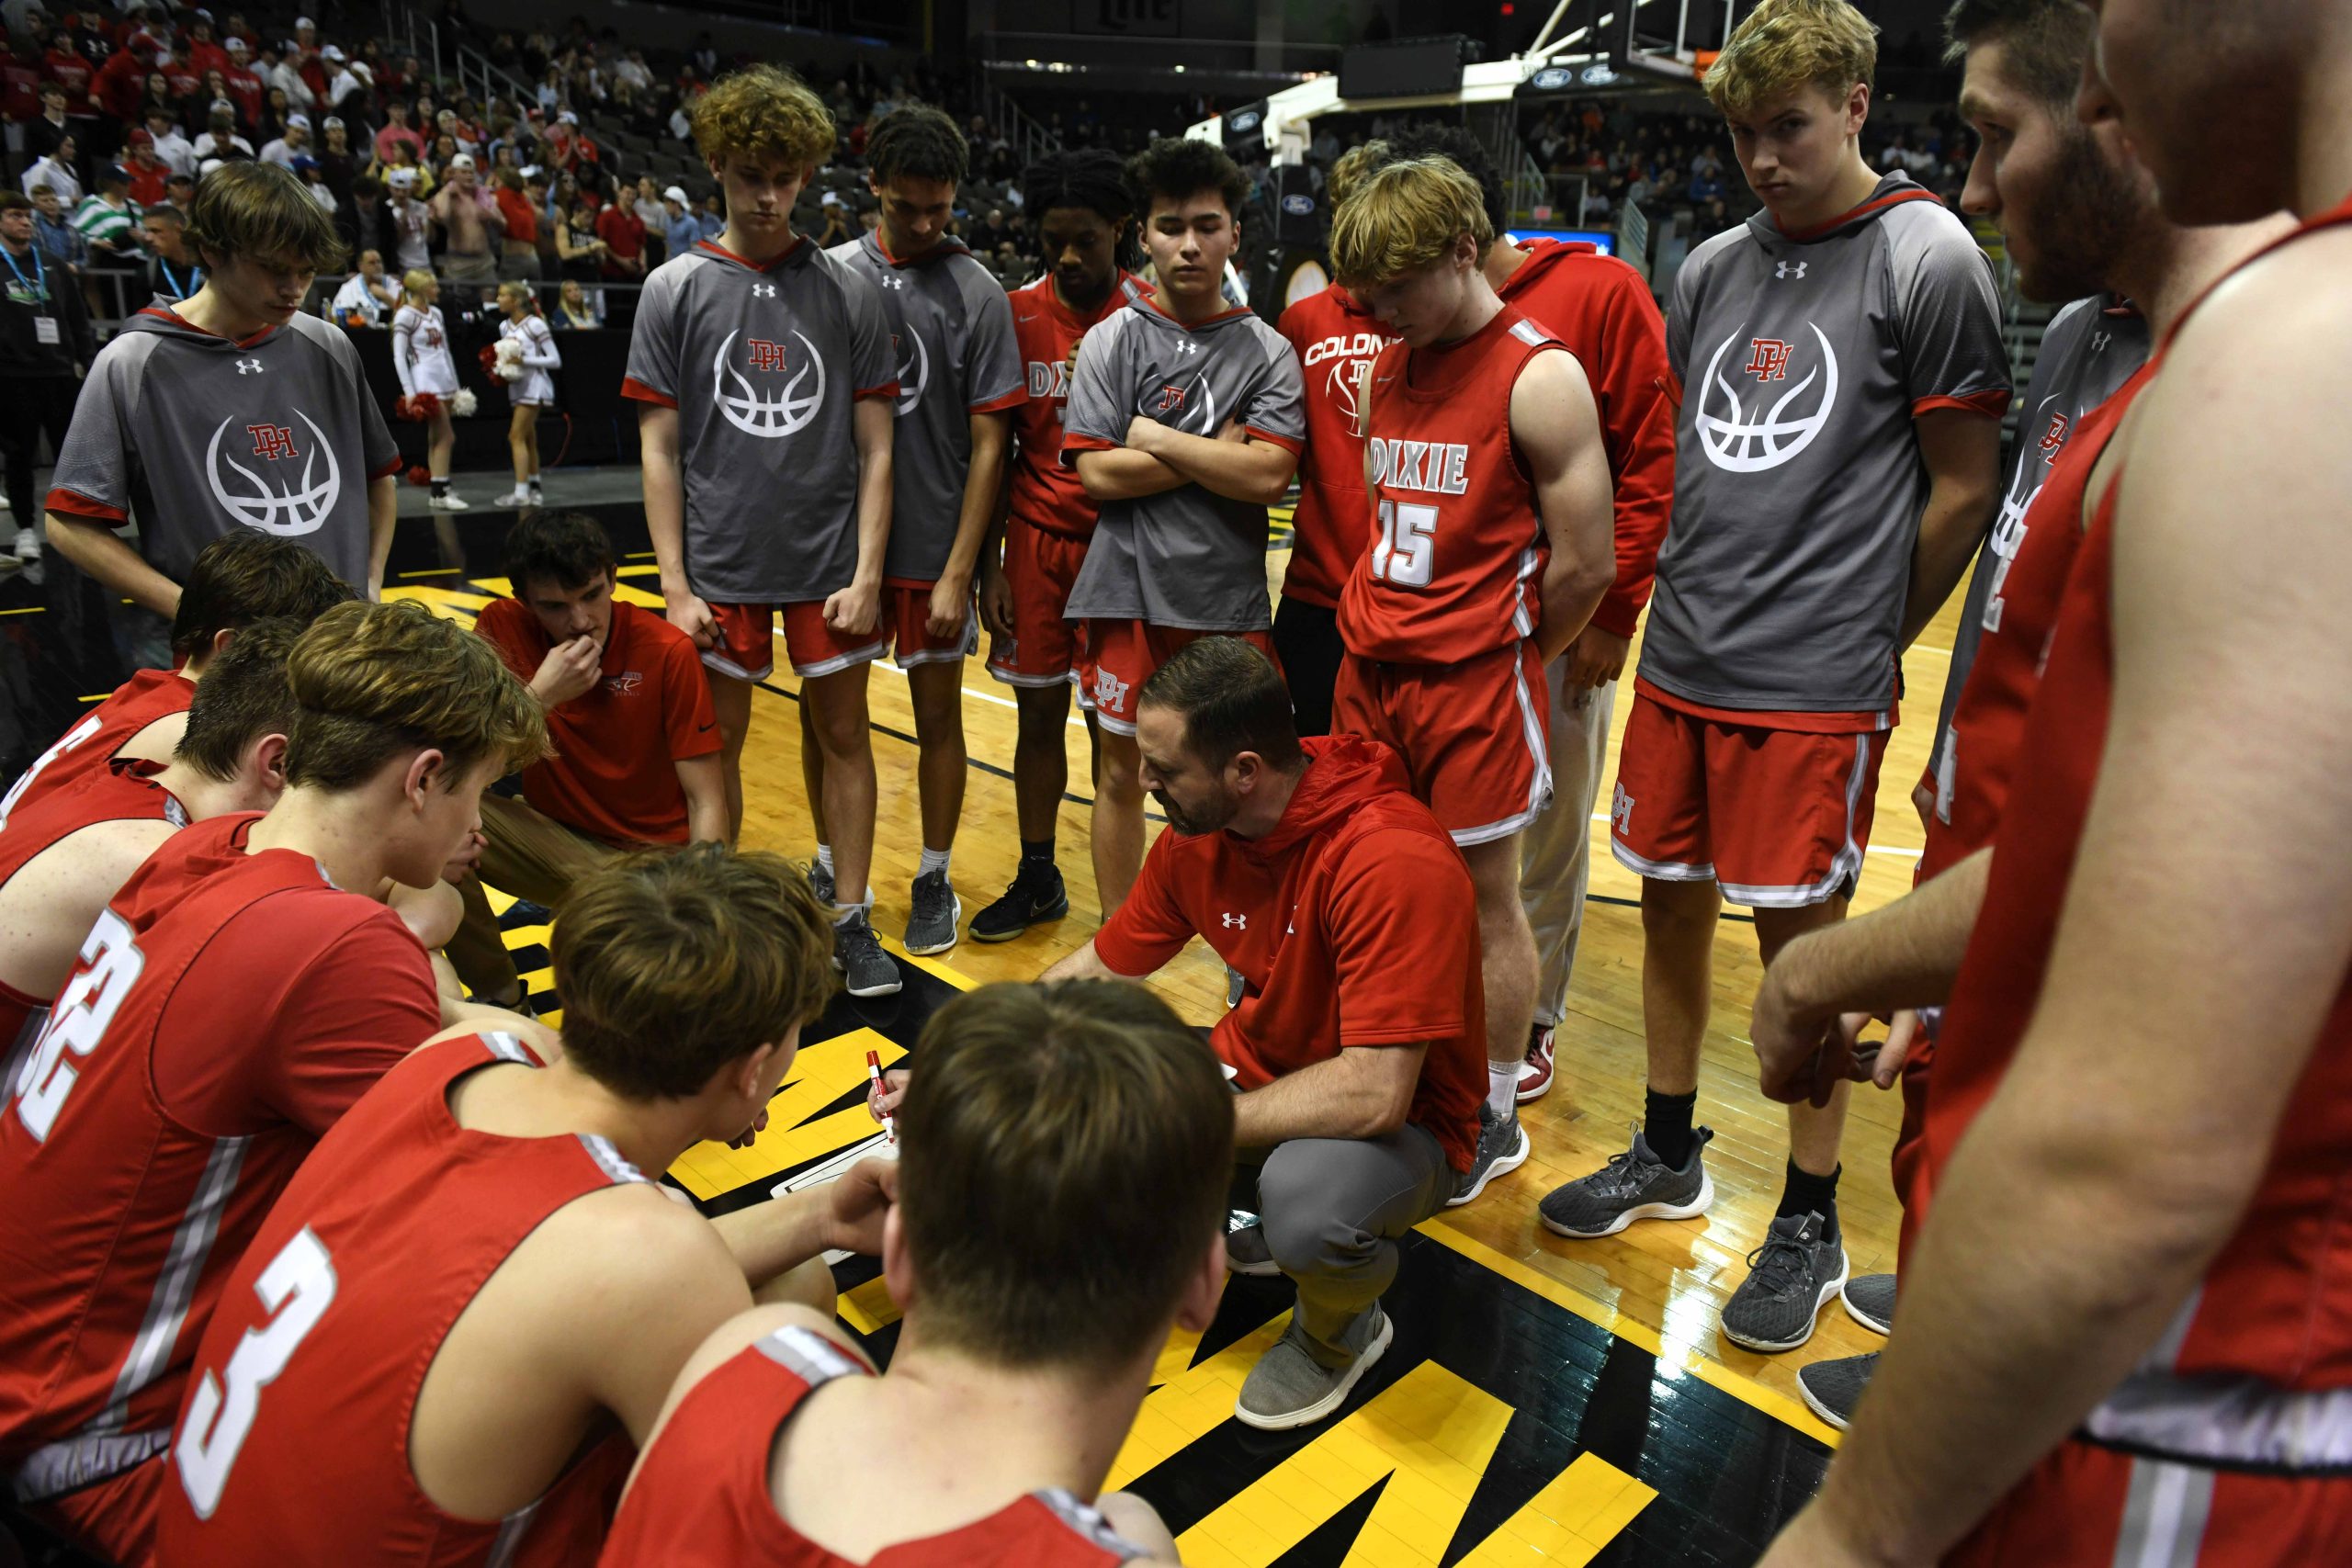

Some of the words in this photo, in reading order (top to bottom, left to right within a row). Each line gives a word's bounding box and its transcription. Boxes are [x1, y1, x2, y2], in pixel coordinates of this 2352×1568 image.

[1028, 360, 1069, 398] DIX
[1305, 333, 1405, 367] COLON
[1370, 436, 1469, 495] DIXIE
[1371, 499, 1440, 588] 15
[175, 1223, 338, 1521] 3
